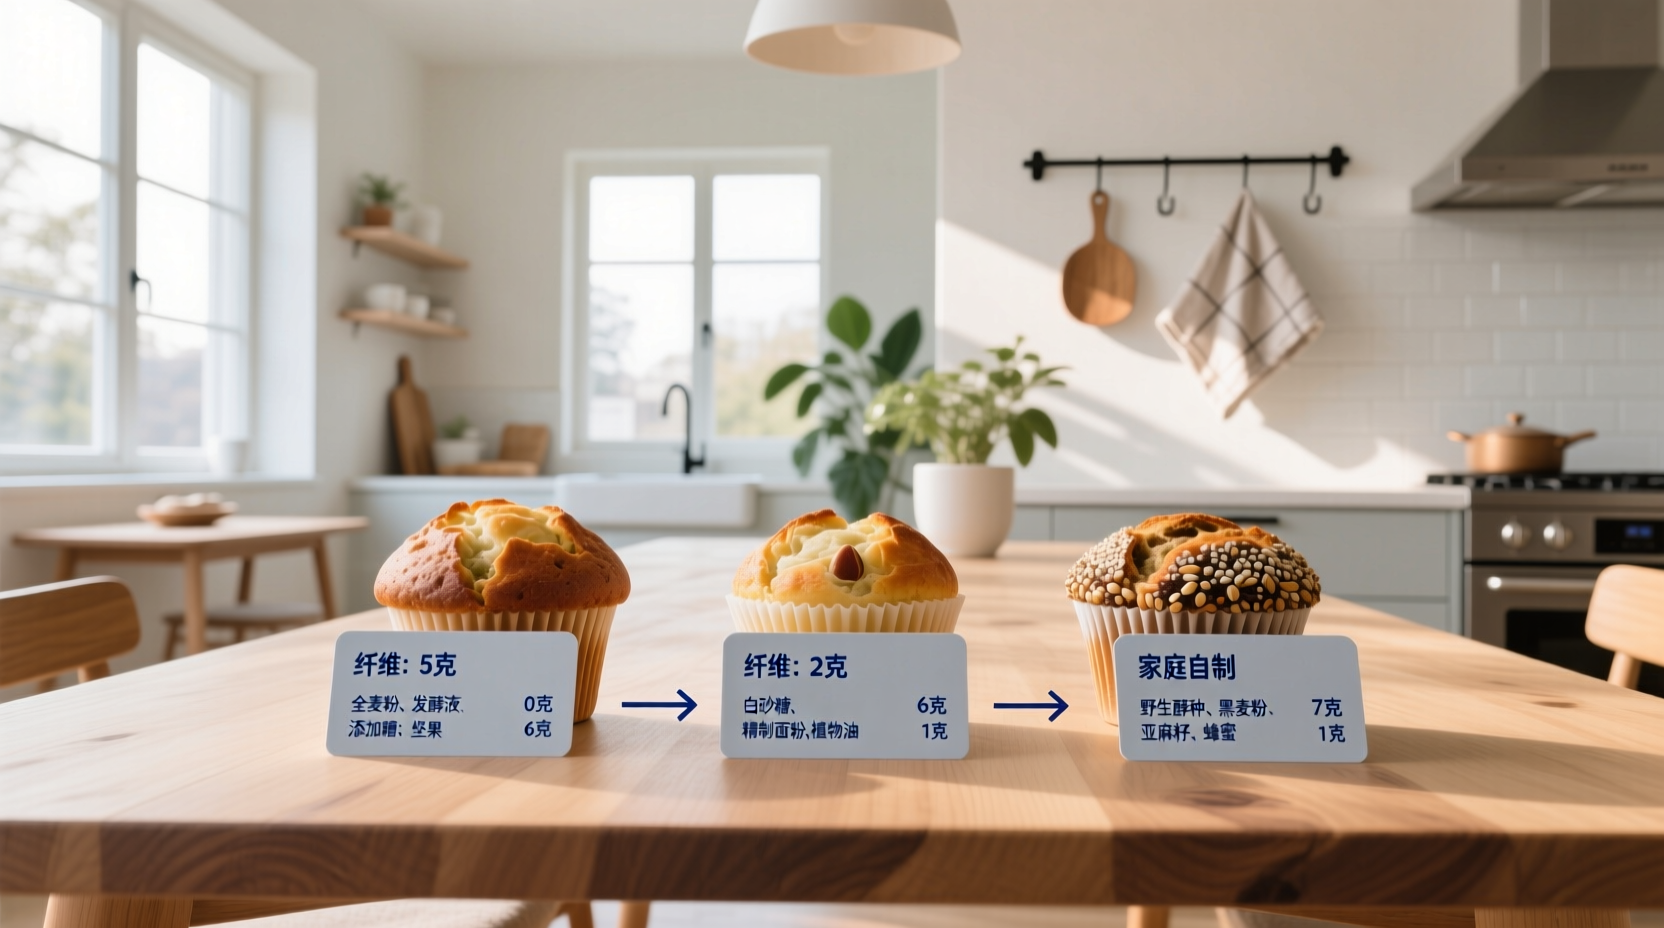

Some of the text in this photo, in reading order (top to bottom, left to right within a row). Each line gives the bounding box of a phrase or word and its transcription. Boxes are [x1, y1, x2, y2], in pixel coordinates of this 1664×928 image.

[1138, 652, 1236, 681] 家庭自制
[523, 694, 554, 713] 0克
[916, 695, 948, 716] 6克
[1311, 696, 1343, 718] 7克
[523, 719, 552, 738] 6克
[921, 721, 949, 741] 1克
[1318, 723, 1346, 744] 1克
